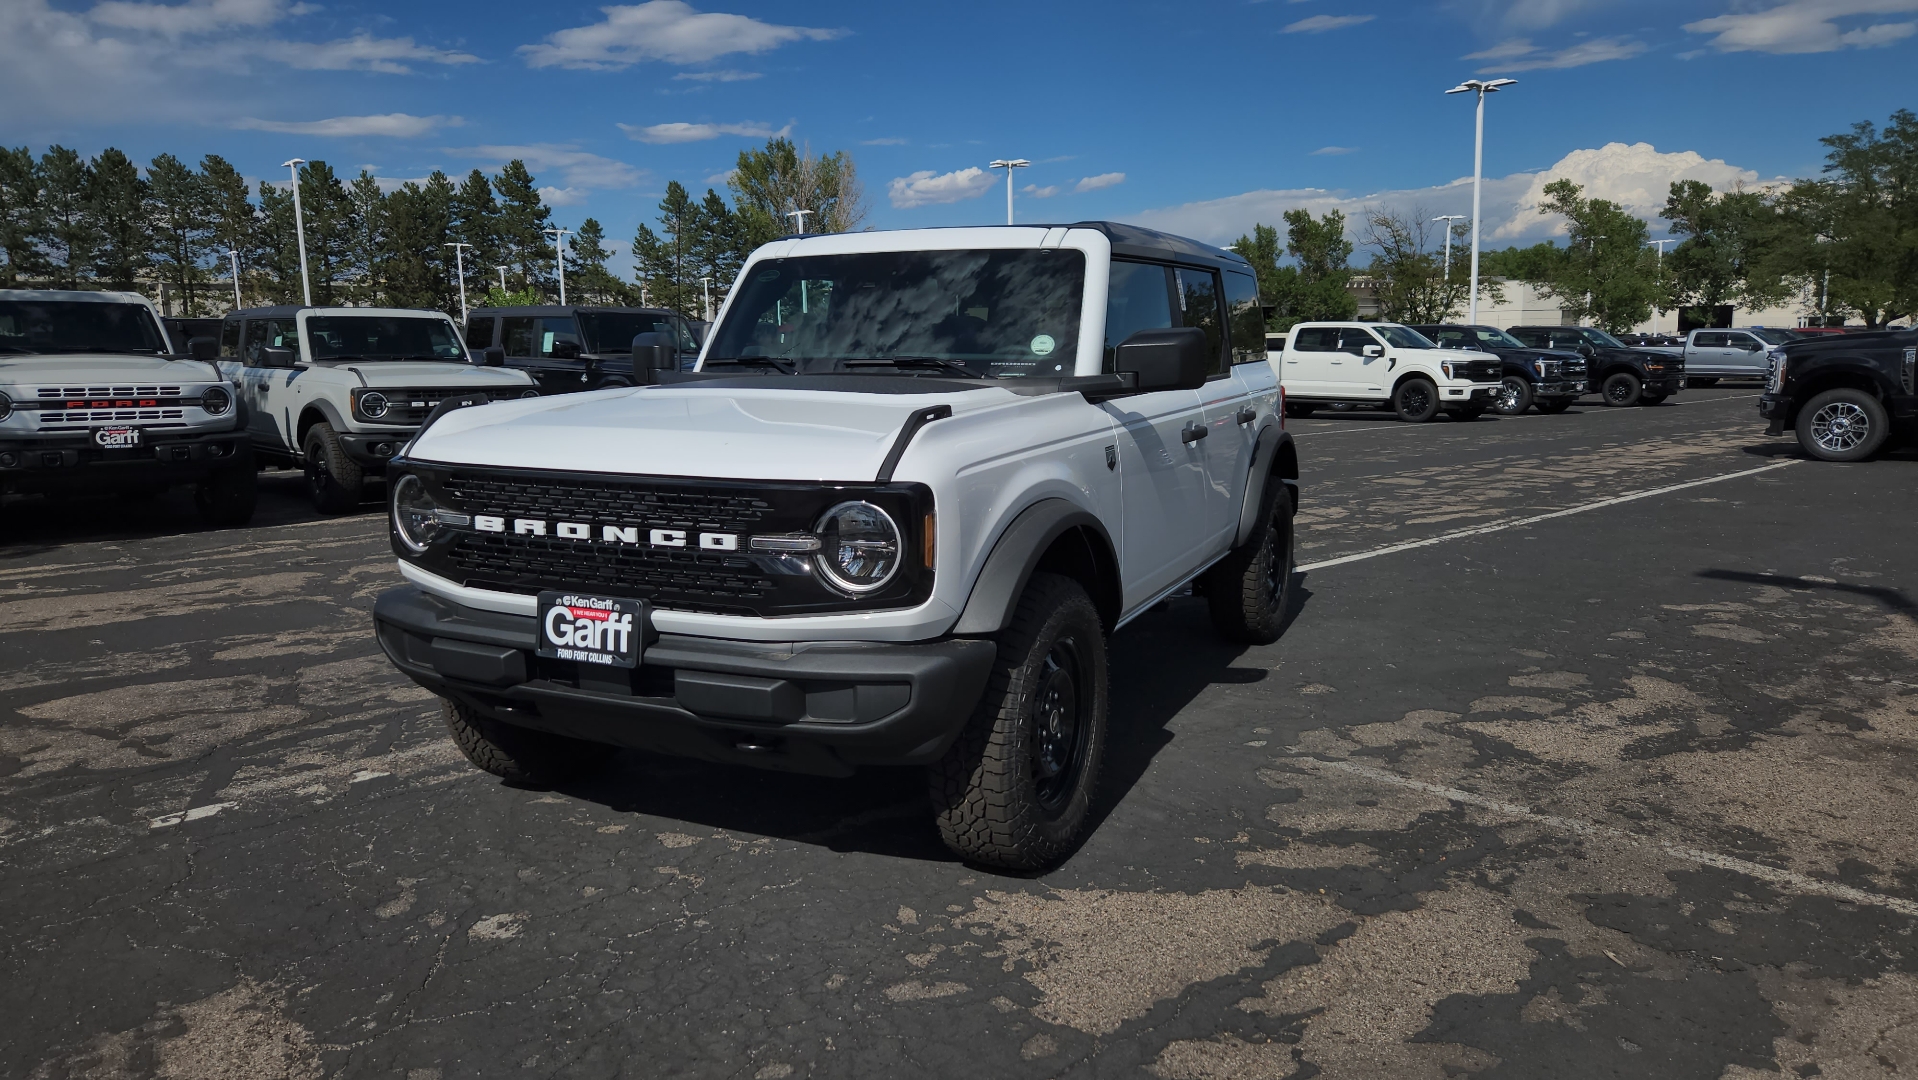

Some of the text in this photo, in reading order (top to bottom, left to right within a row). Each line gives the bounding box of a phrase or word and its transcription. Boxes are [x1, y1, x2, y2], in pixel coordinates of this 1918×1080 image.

[66, 400, 157, 408] FORD
[95, 430, 139, 445] Garff
[474, 515, 738, 550] BRONCO
[571, 596, 613, 610] Ken Garff
[545, 605, 632, 653] Garff
[557, 648, 613, 665] FORD FORT COLLINS
